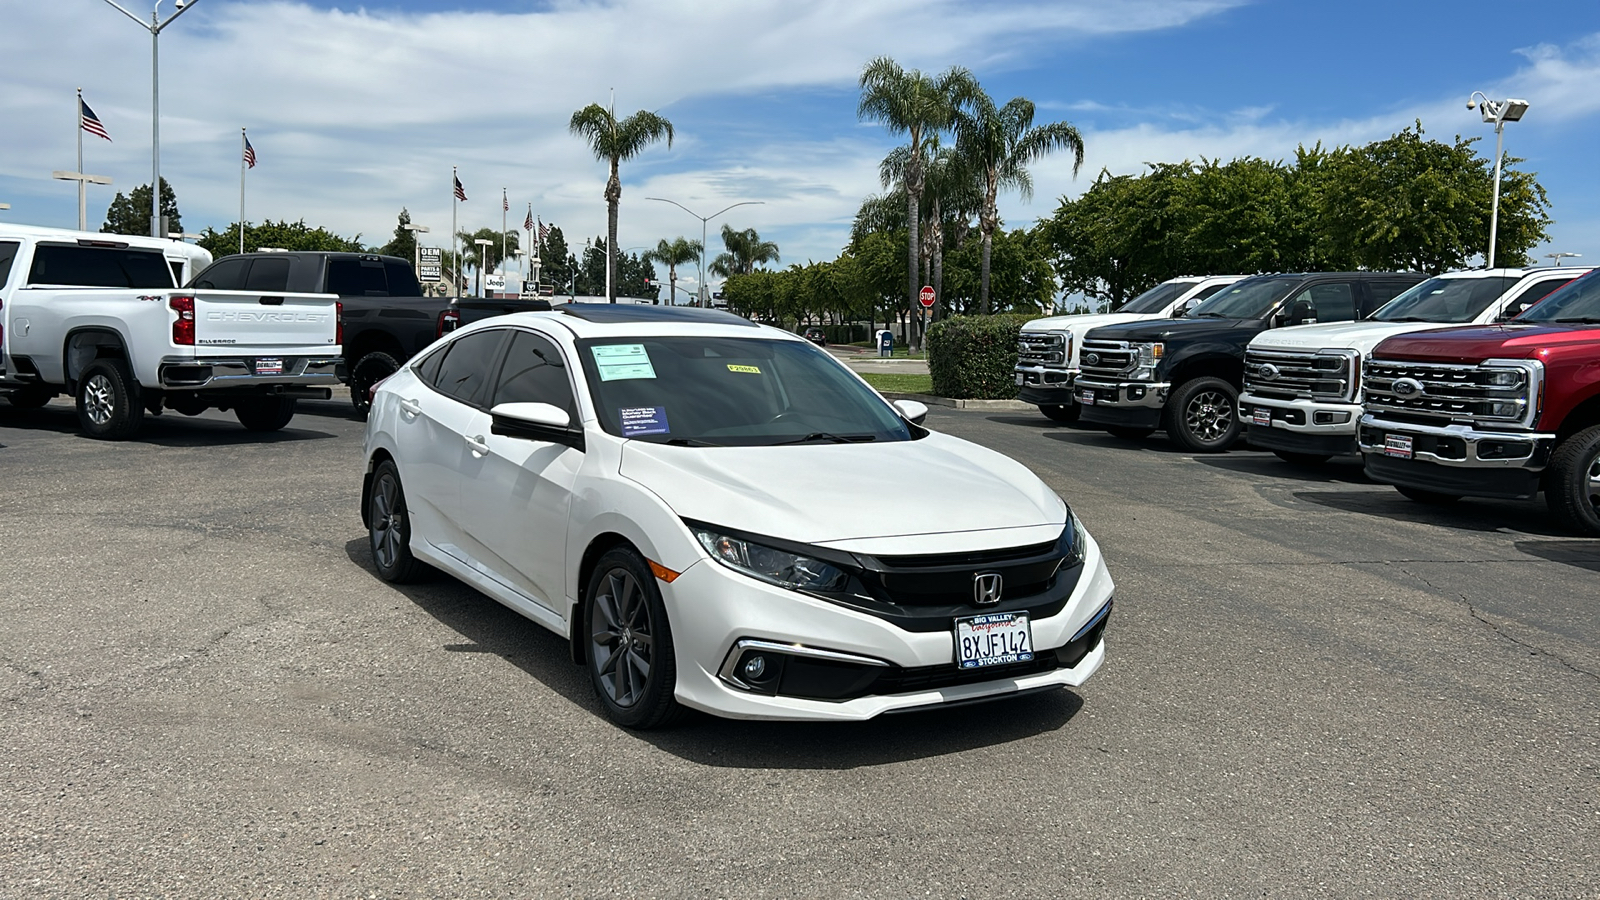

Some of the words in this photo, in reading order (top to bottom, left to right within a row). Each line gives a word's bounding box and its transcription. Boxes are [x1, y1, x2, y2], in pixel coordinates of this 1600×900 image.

[421, 248, 440, 256] OEM
[486, 279, 505, 287] Jeep
[921, 292, 934, 300] STOP
[206, 311, 330, 323] CHEVROLET
[974, 616, 987, 624] BIG
[988, 614, 1013, 622] VALLEY
[963, 631, 1027, 658] 8XJF142
[977, 653, 1018, 666] STOCKTON
